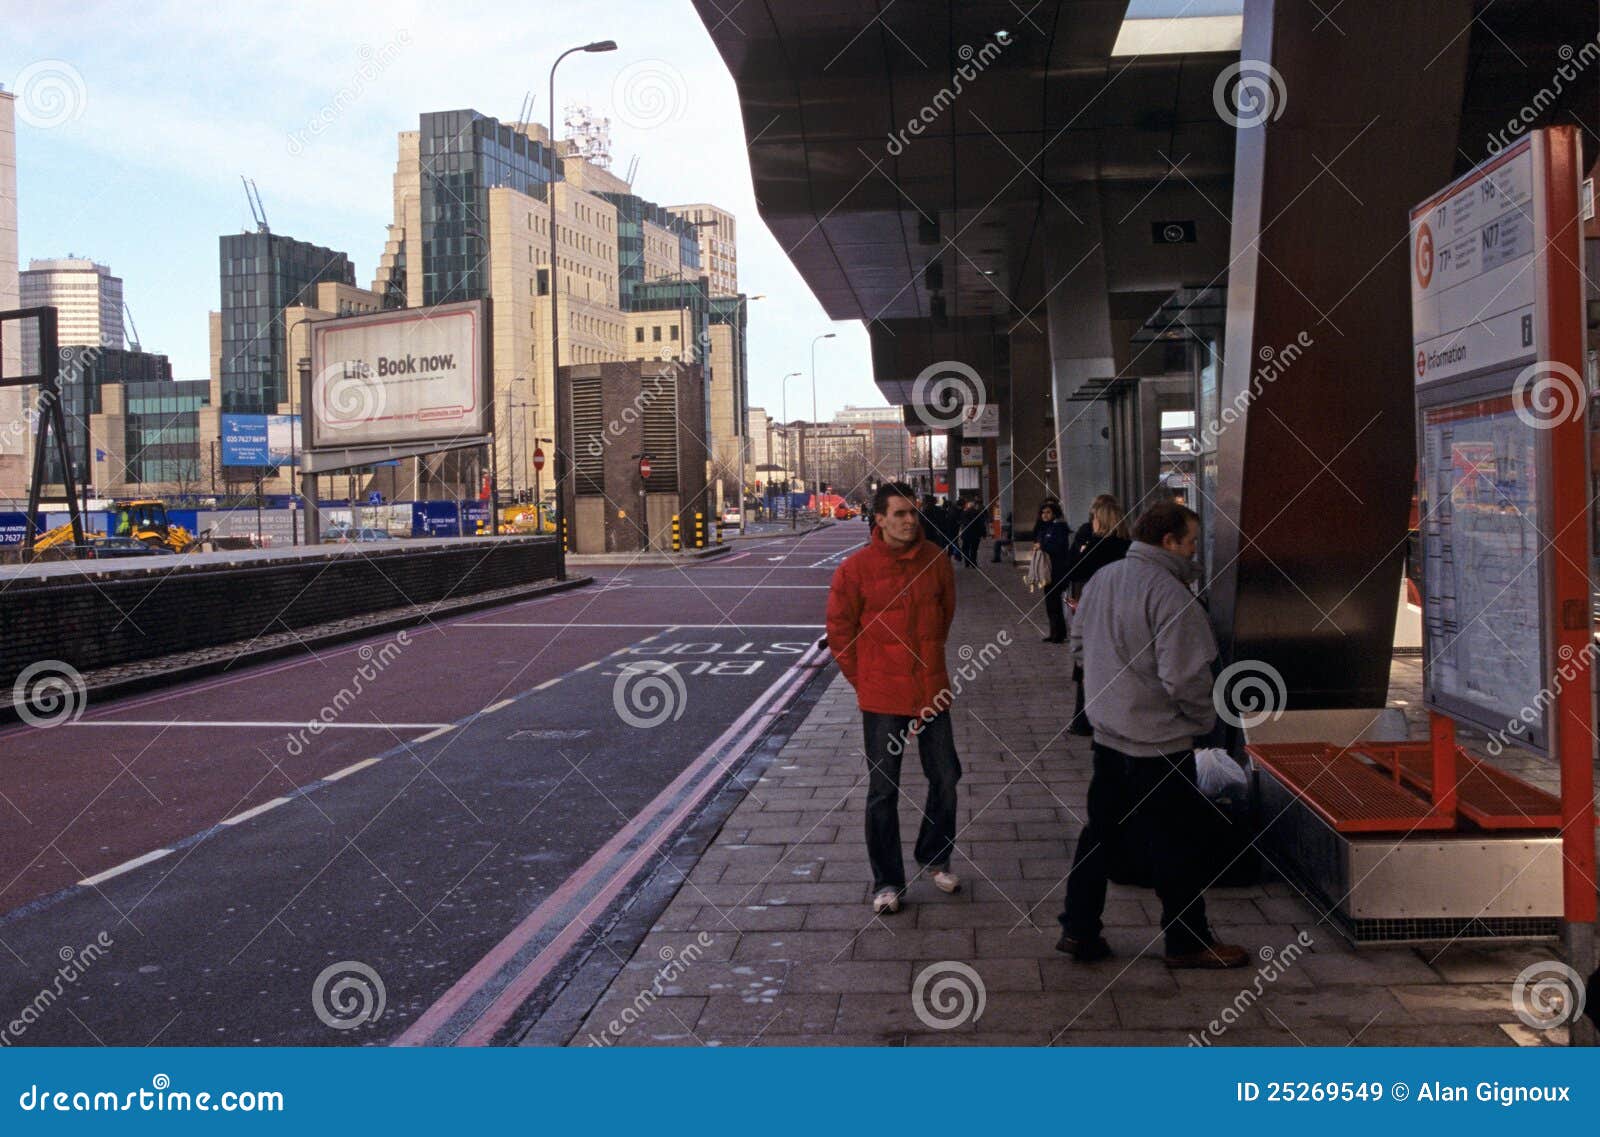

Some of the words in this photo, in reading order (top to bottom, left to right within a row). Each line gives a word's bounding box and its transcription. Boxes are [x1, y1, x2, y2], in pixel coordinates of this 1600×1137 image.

[1482, 222, 1500, 250] N77
[343, 360, 374, 380] Life.
[378, 353, 416, 377] Book
[420, 353, 457, 373] now.
